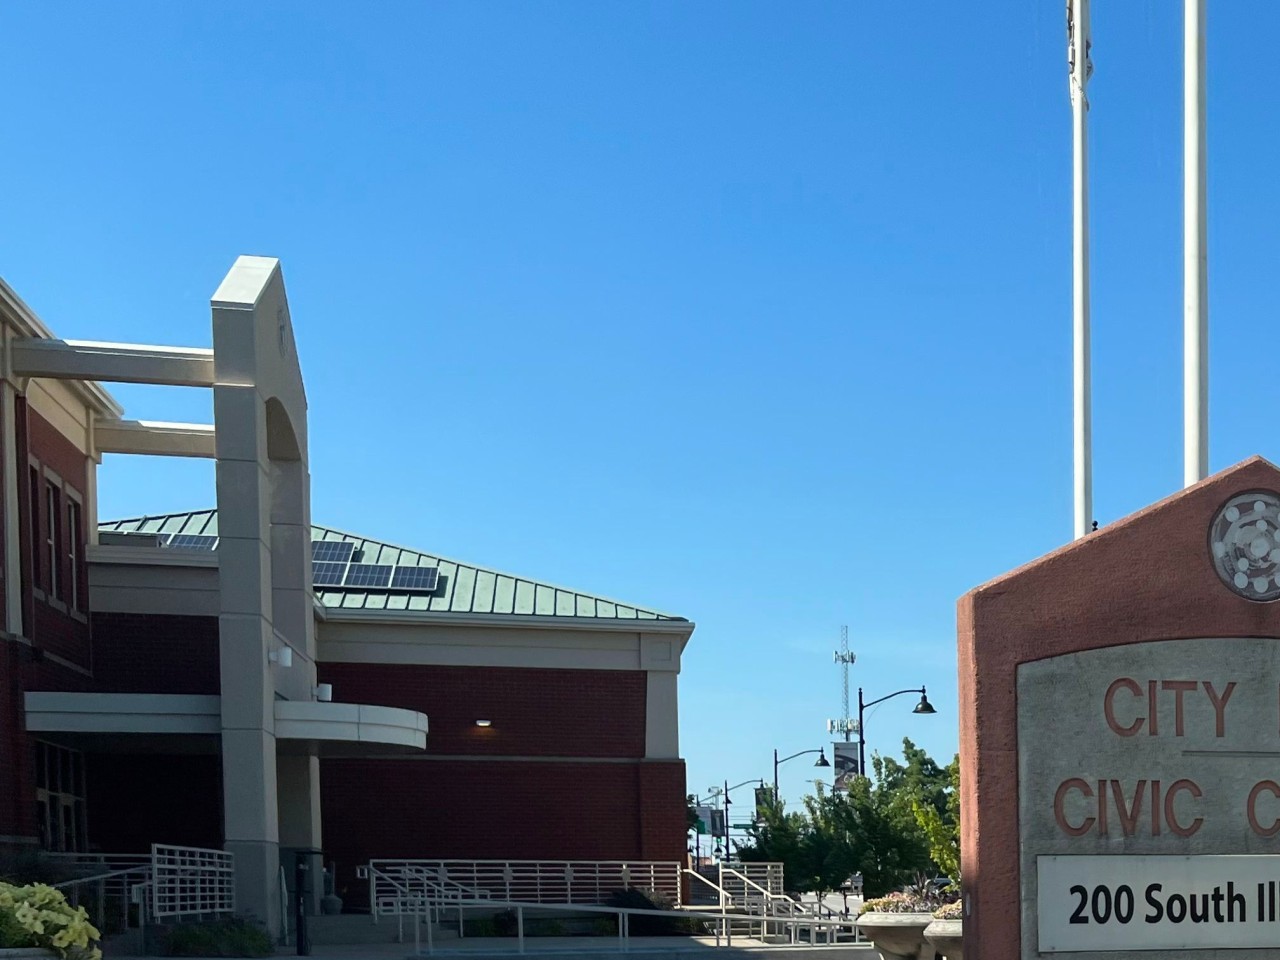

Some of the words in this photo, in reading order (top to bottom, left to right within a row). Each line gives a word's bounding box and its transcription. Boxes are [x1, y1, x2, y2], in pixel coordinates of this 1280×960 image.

[1104, 677, 1236, 738] CITY
[1053, 777, 1203, 837] CIVIC
[1069, 884, 1134, 924] 200
[1145, 881, 1246, 924] South
